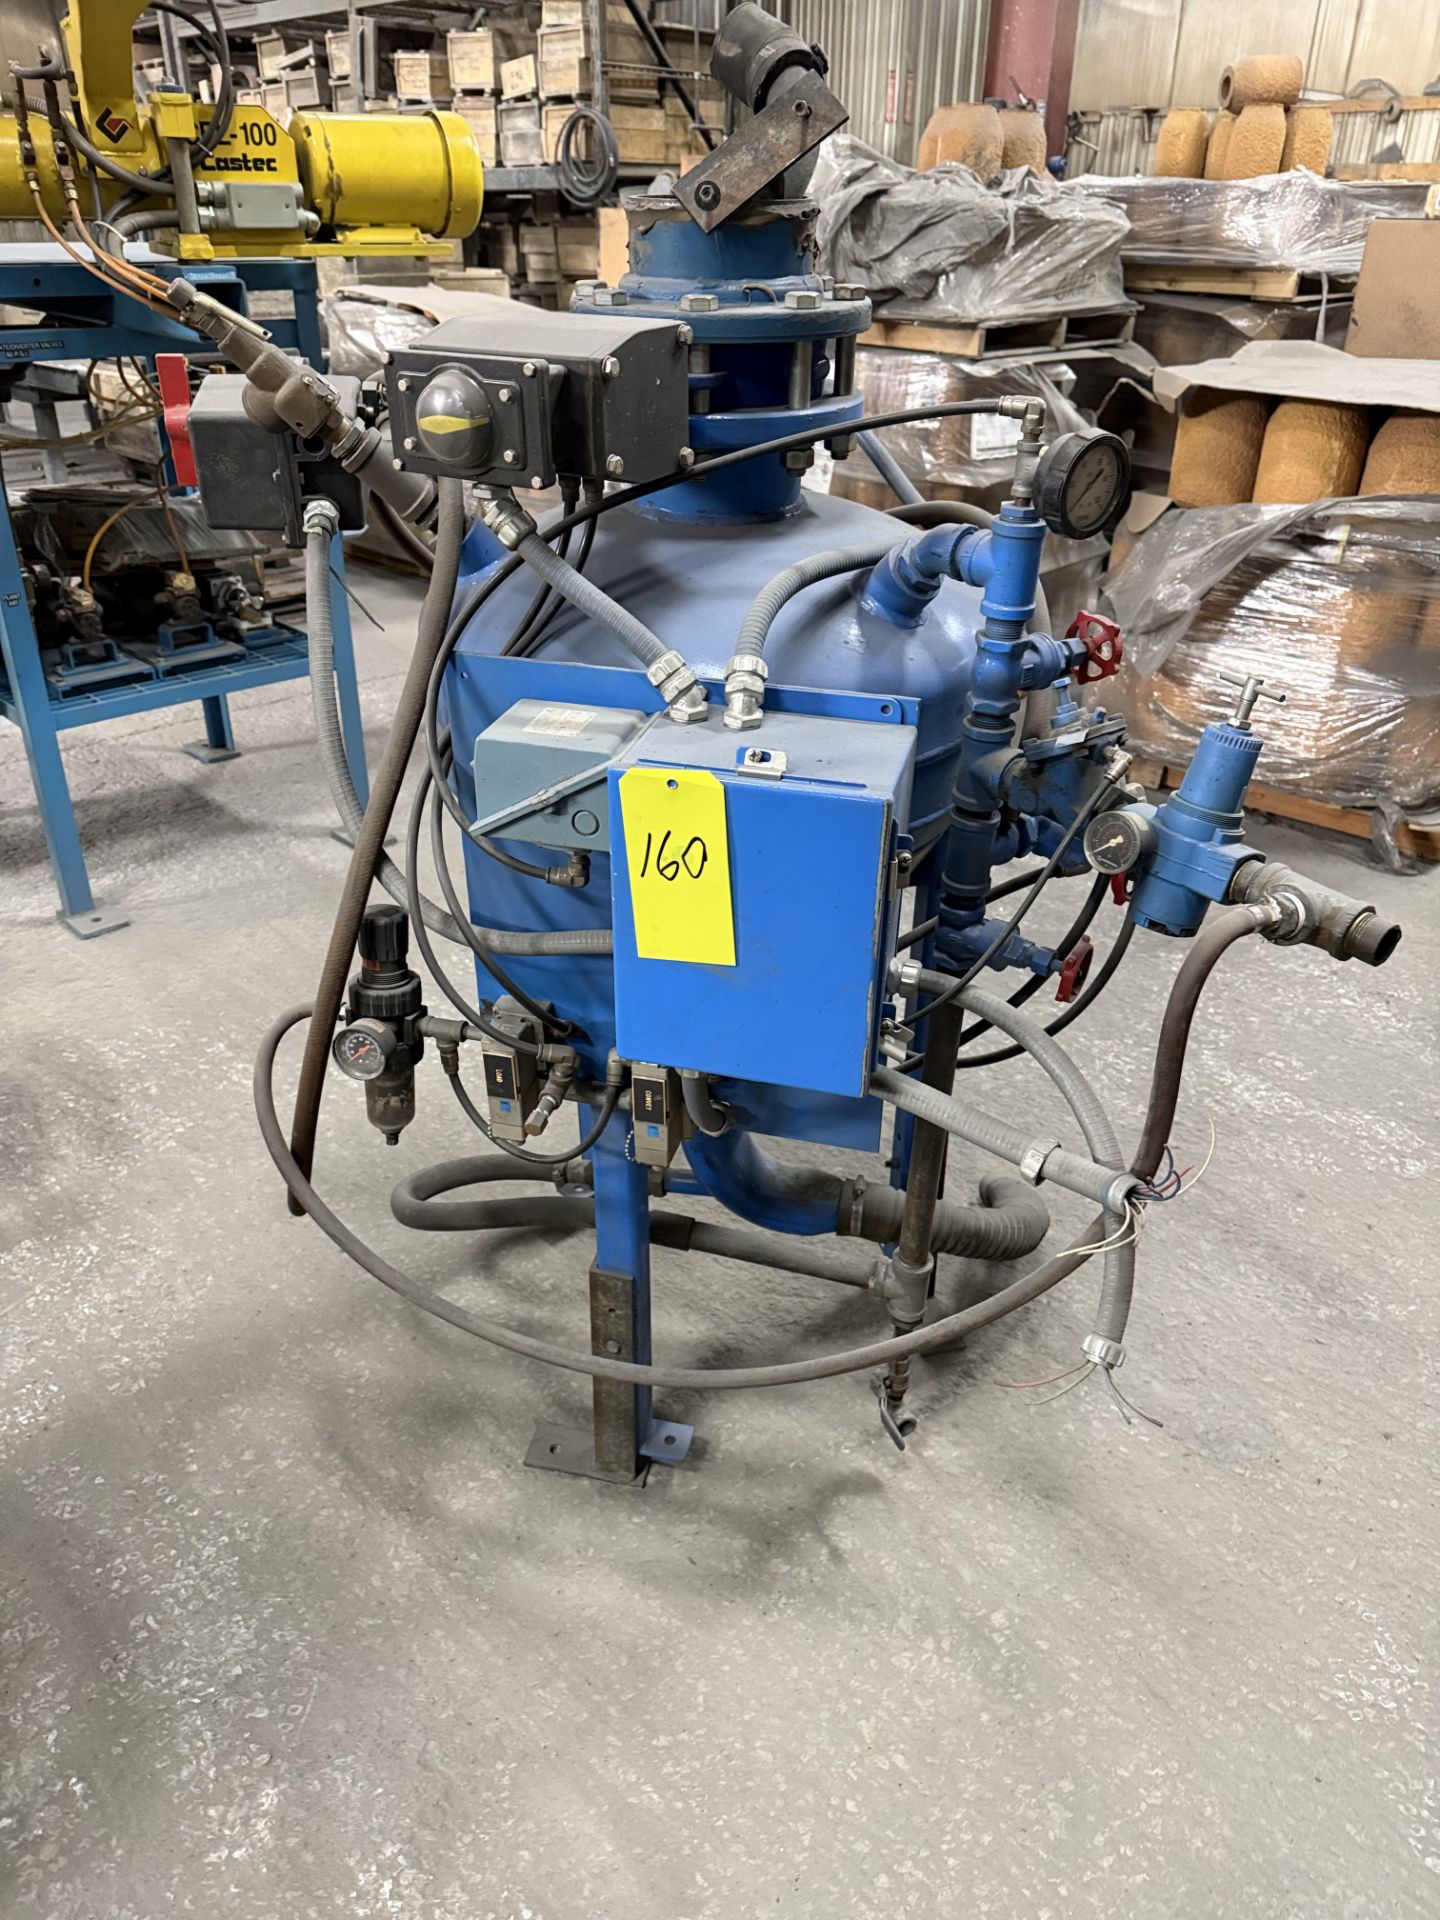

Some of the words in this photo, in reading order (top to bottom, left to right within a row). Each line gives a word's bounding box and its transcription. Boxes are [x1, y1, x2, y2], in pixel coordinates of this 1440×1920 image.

[200, 153, 277, 172] Castec
[640, 829, 708, 881] 160
[495, 1068, 504, 1083] LOAD
